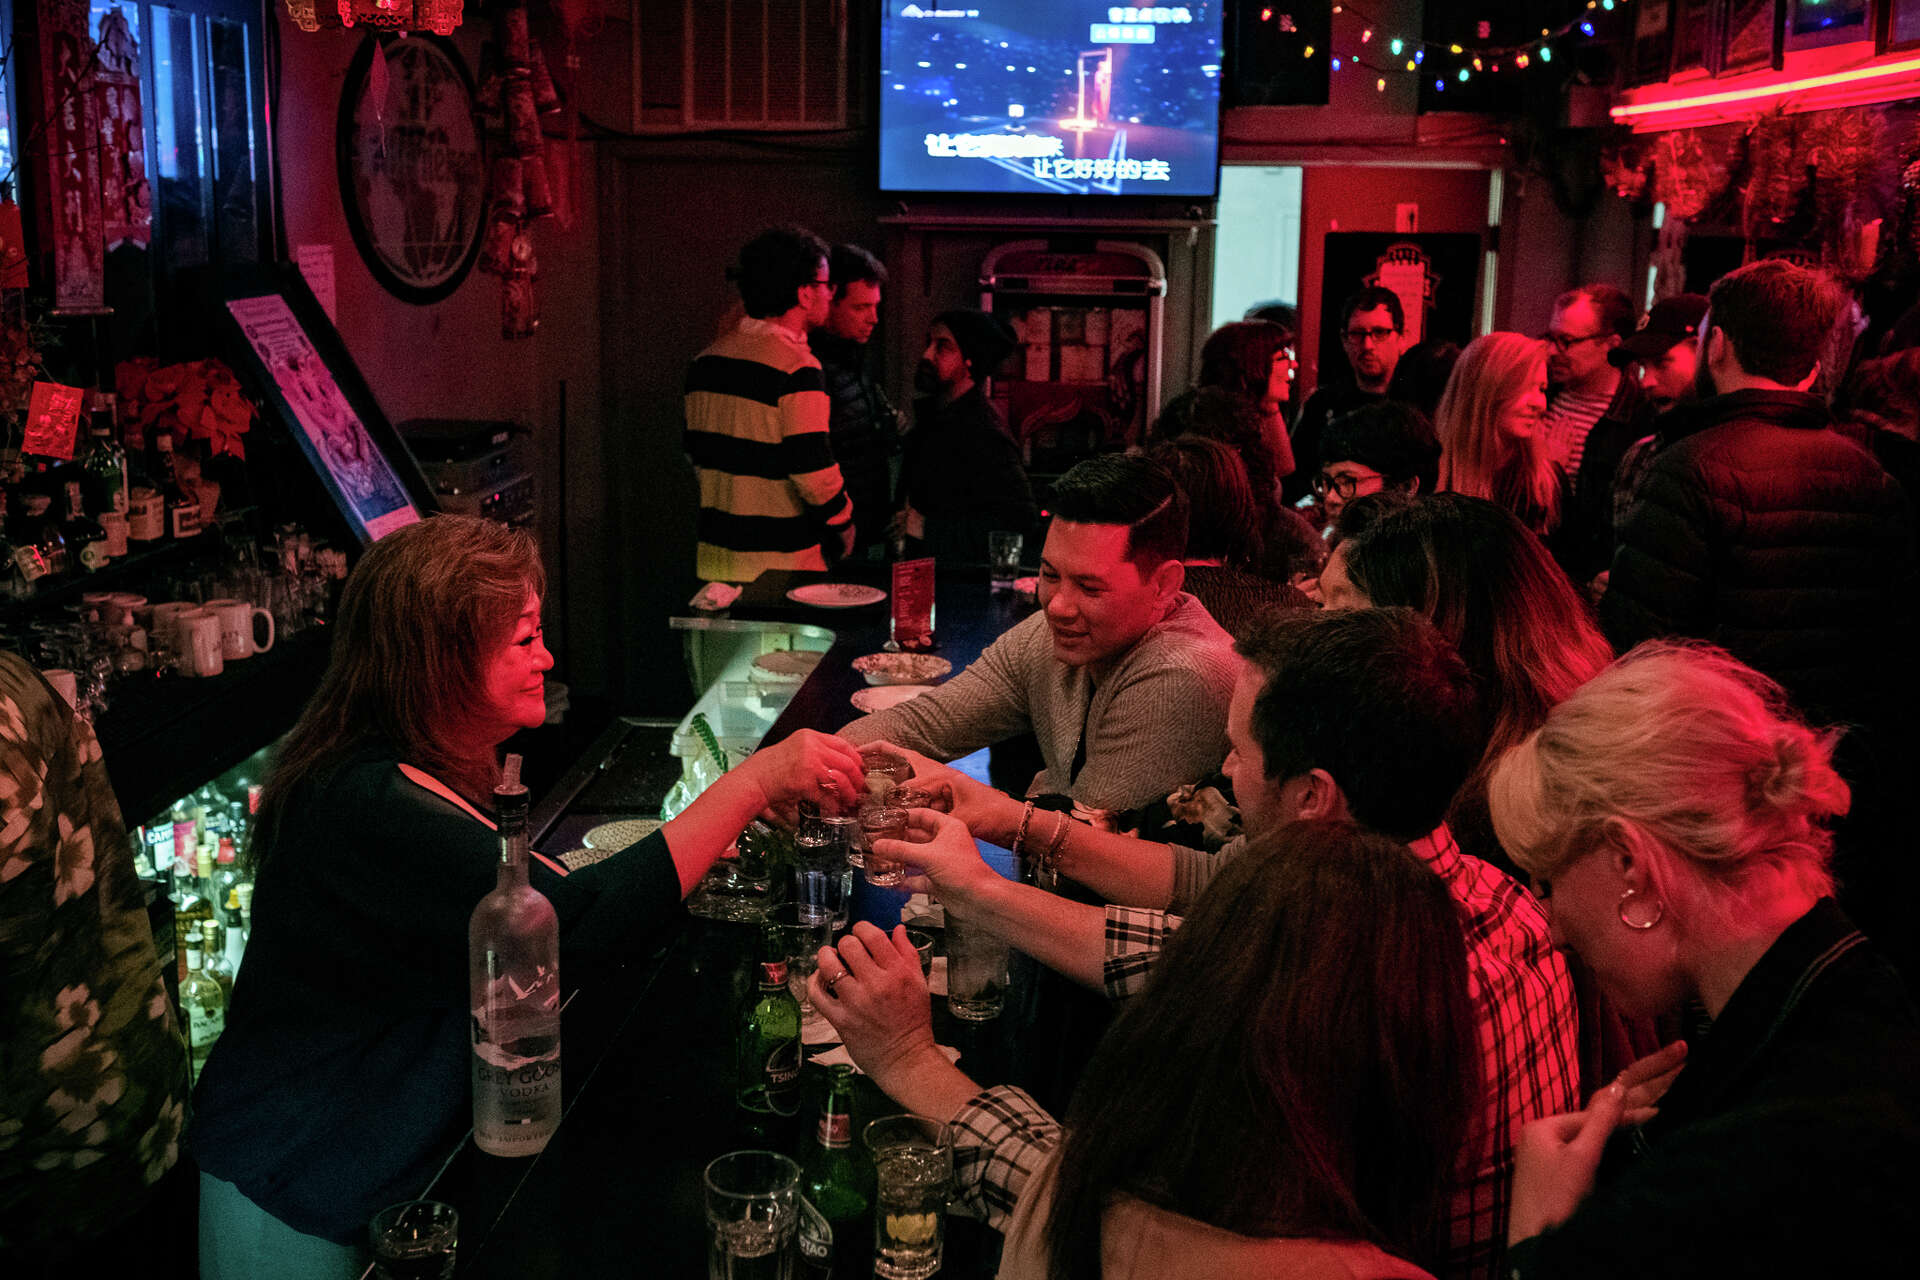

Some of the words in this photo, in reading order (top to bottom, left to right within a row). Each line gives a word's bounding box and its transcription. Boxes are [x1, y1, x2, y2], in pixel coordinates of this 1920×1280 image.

[1033, 158, 1170, 181] 让它好好的去
[478, 1067, 513, 1086] GREY
[519, 1059, 561, 1084] GOOS
[500, 1083, 549, 1098] VODKA
